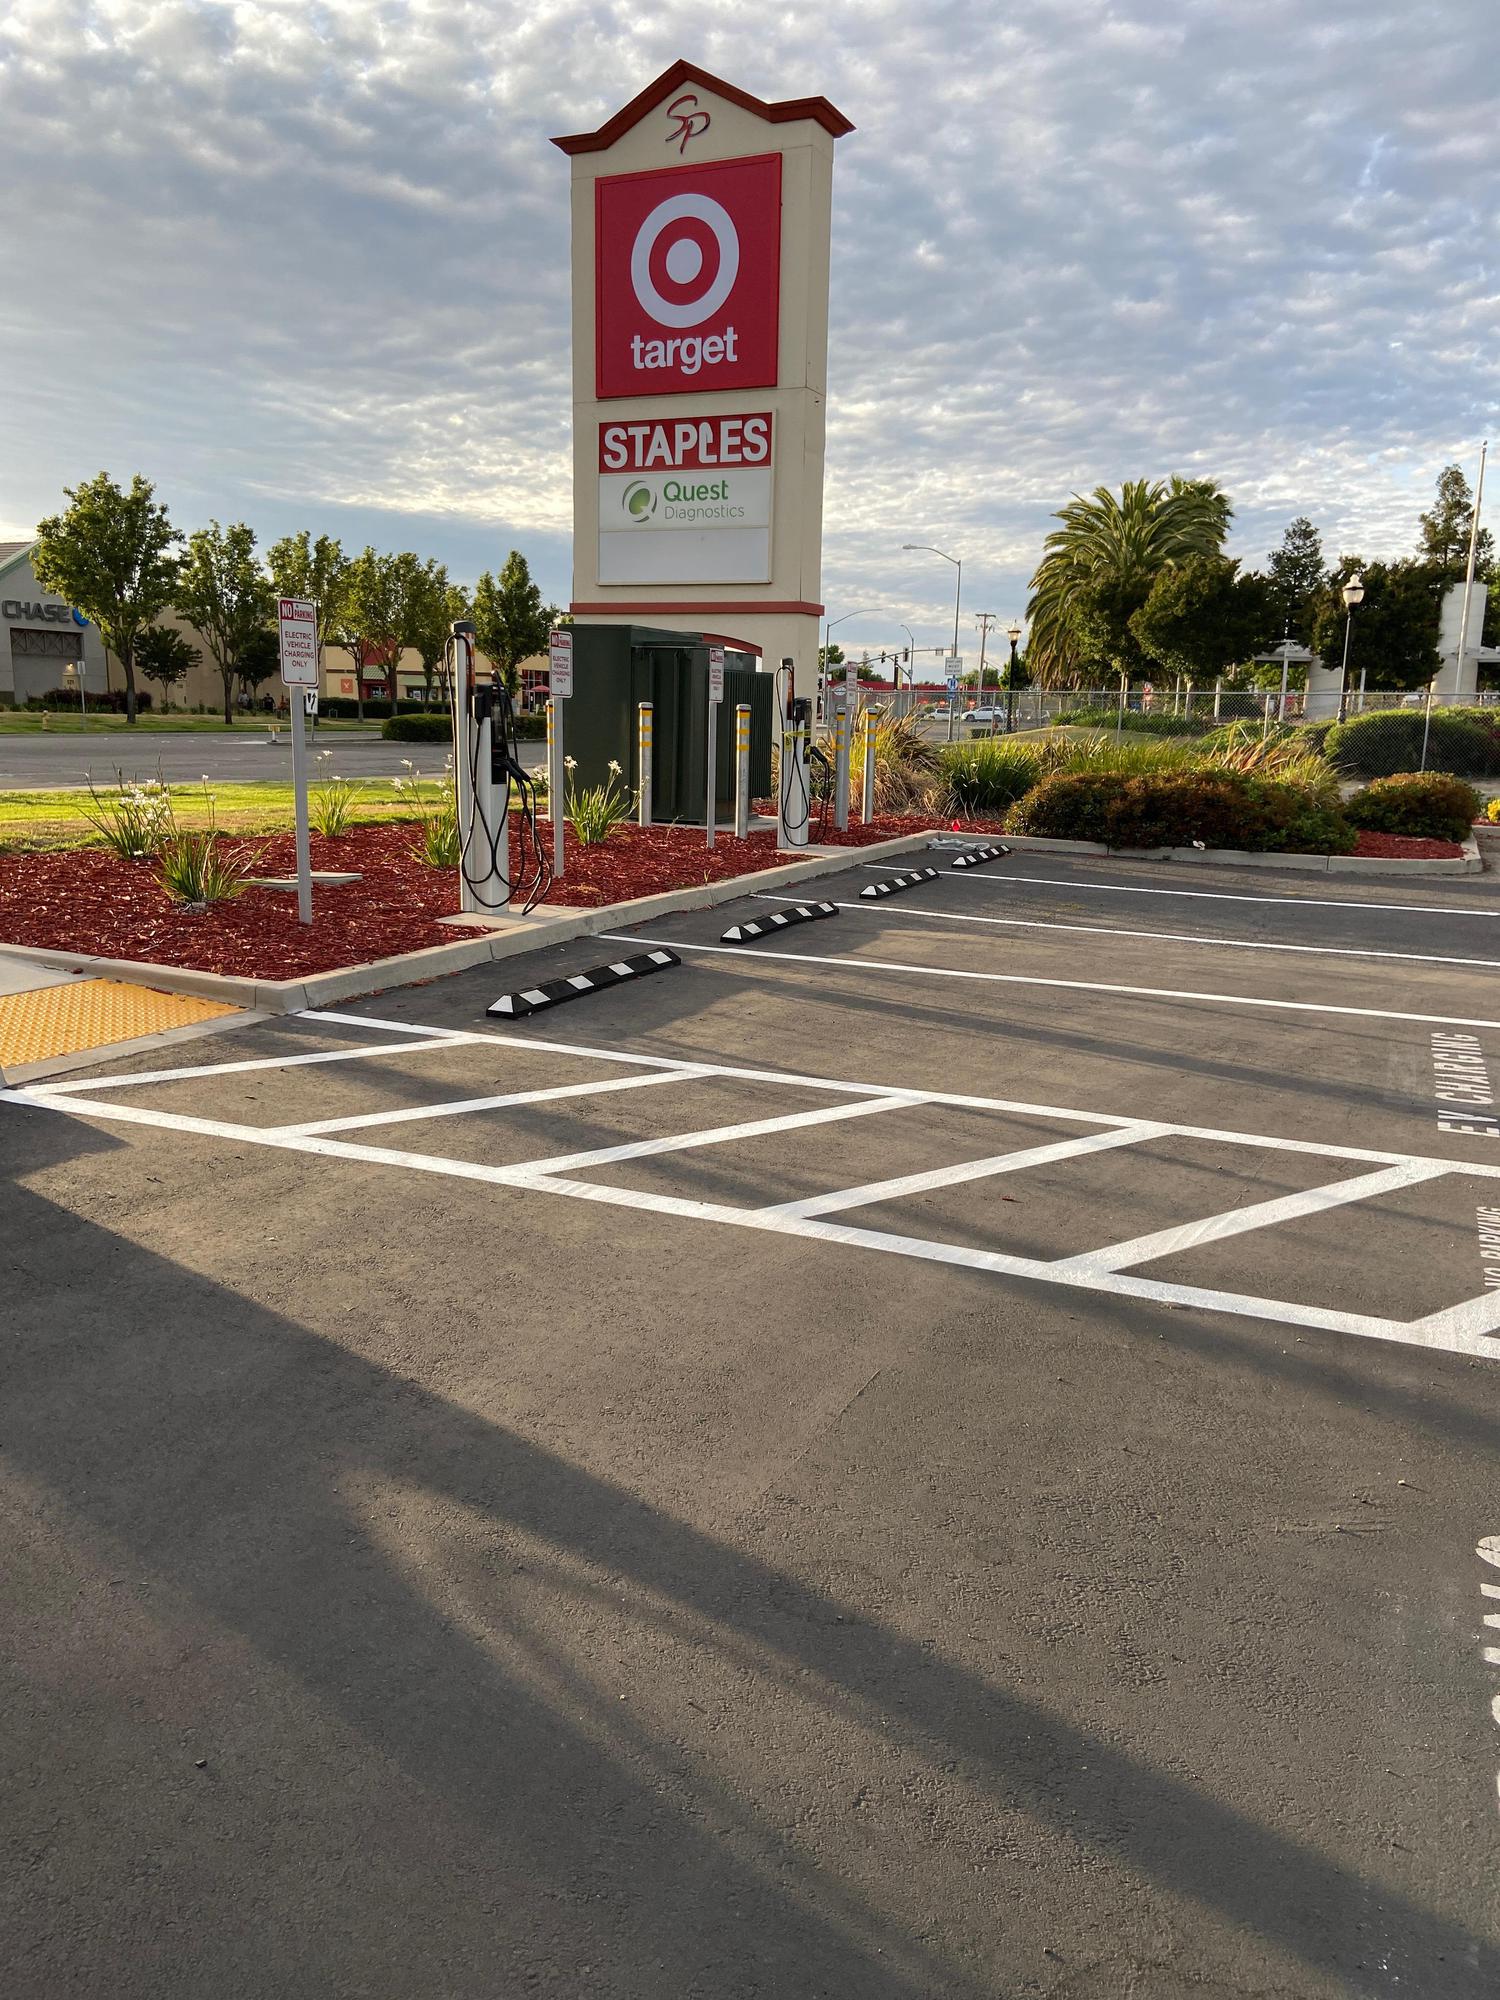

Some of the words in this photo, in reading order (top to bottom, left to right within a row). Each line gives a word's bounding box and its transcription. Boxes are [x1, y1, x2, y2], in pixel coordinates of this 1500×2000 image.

[631, 327, 738, 375] target
[603, 418, 768, 469] STAPLES
[663, 480, 729, 502] Quest
[664, 504, 745, 521] Diagnostics
[2, 600, 71, 623] CHASE
[282, 602, 292, 618] NO
[294, 609, 313, 619] PARKING
[285, 631, 312, 640] ELECTRIC
[287, 641, 311, 649] VEHICLE
[284, 650, 315, 659] CHARGING
[292, 660, 308, 668] ONLY
[1430, 1032, 1494, 1104] CHARGING
[1437, 1109, 1500, 1138] EV
